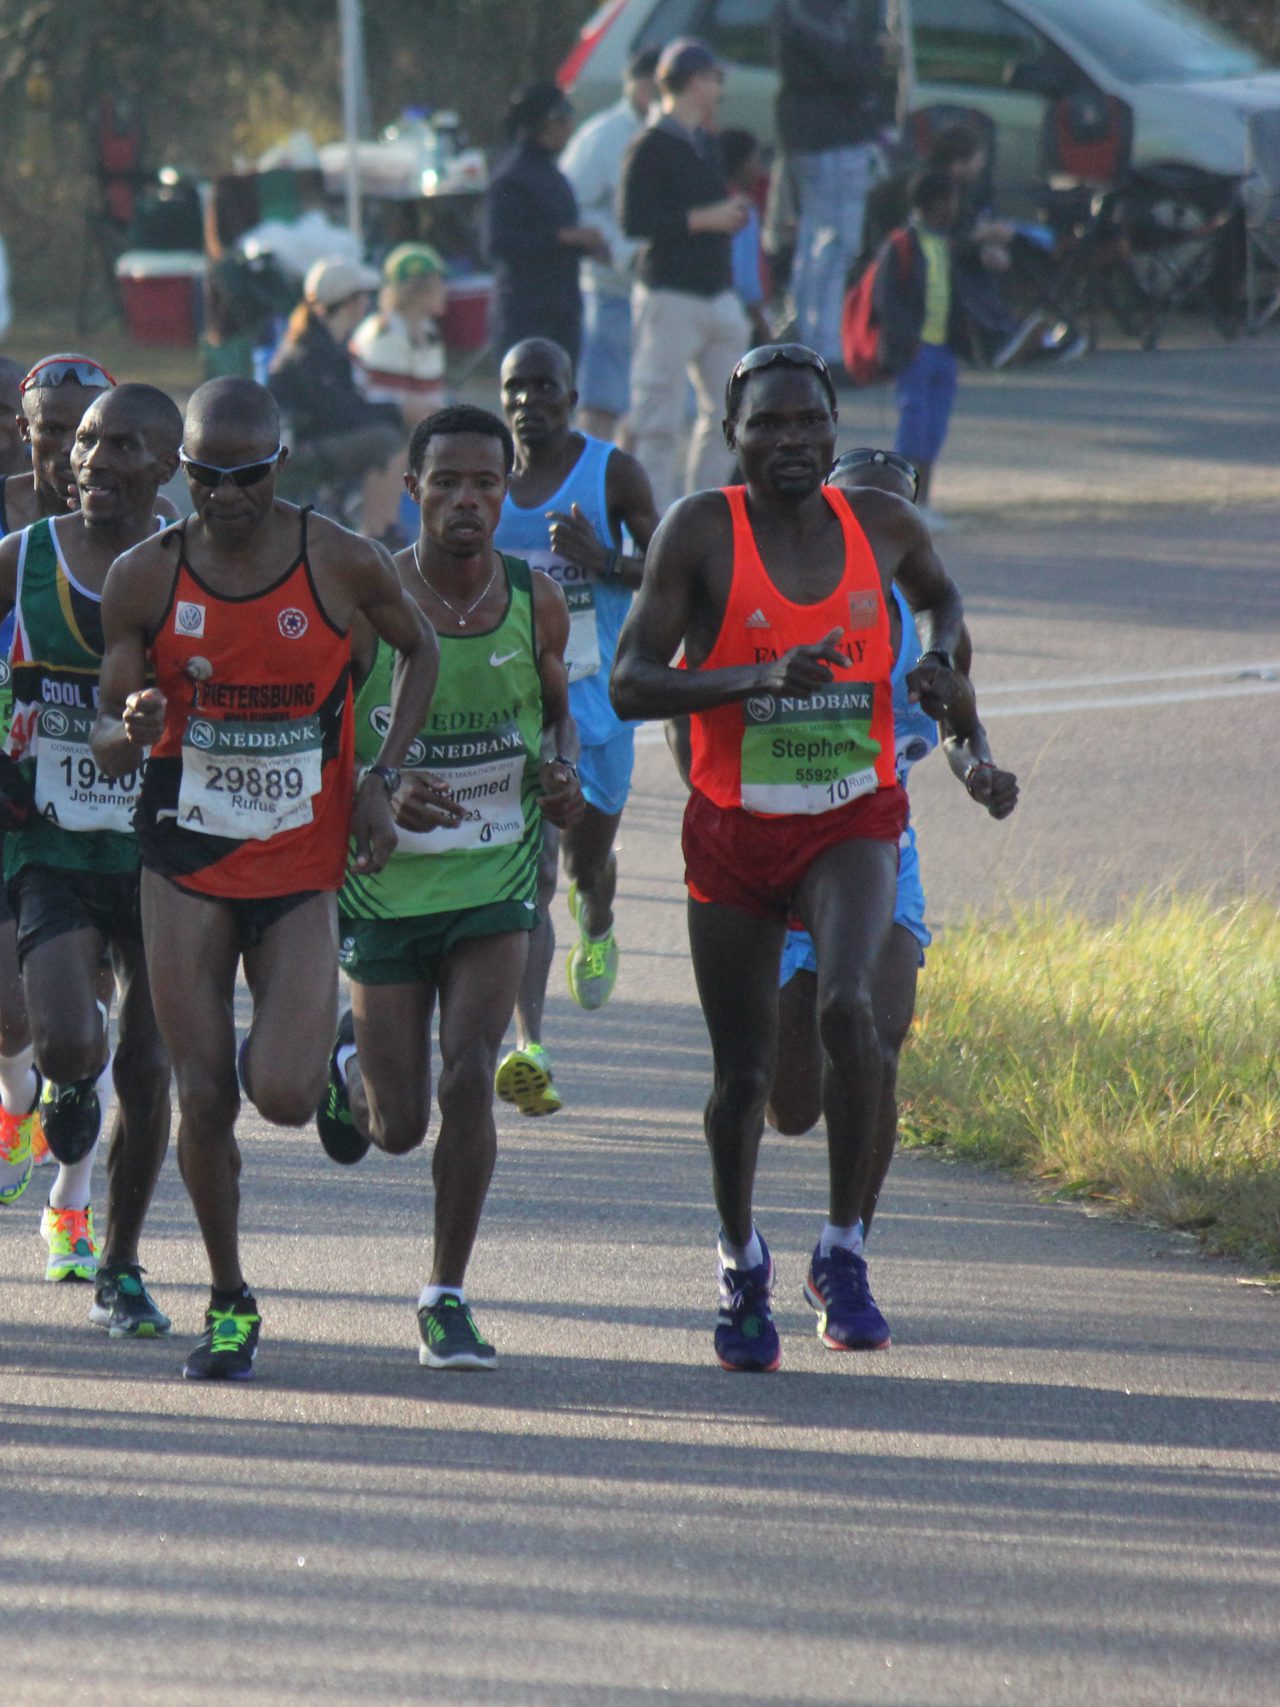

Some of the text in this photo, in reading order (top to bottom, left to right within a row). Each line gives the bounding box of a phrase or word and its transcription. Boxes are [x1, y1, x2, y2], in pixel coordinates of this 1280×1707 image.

[41, 677, 87, 709] COOL
[202, 682, 316, 709] PIETERSBURG
[780, 694, 870, 713] NEDBANK
[50, 743, 91, 754] COMRAD
[219, 726, 316, 748] NEDBANK
[431, 731, 524, 760] NEDBANK
[771, 738, 855, 762] Stephen
[204, 765, 303, 801] 29889
[451, 774, 511, 803] mmed
[826, 773, 874, 804] 10 Runs
[69, 789, 140, 806] Johanne
[231, 795, 277, 813] Rufus
[43, 801, 60, 824] A
[185, 805, 205, 826] A
[492, 820, 520, 833] Runs
